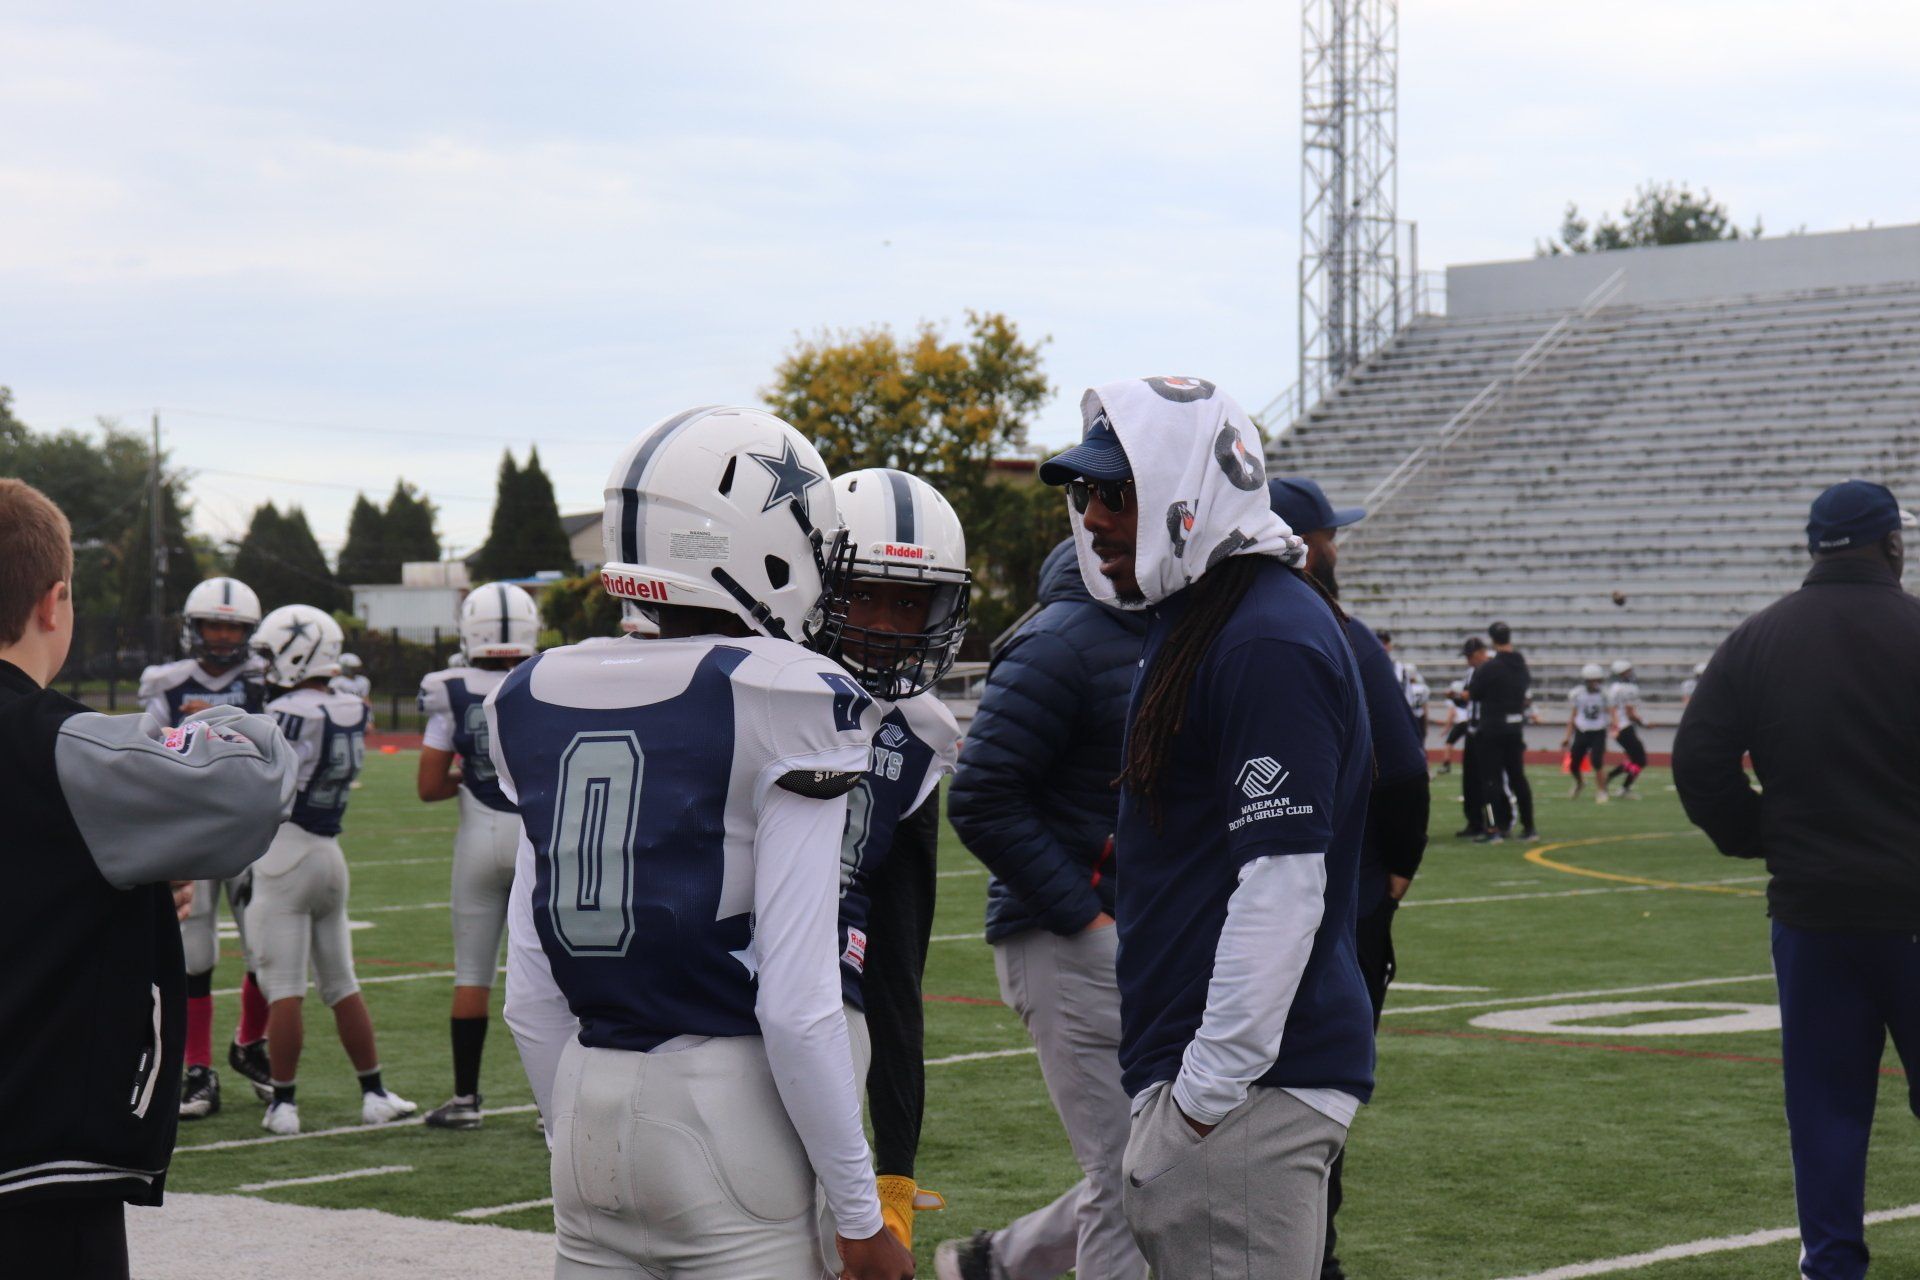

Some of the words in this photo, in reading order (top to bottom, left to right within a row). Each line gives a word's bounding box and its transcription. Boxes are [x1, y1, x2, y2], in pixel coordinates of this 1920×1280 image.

[885, 544, 923, 559] Riddell
[601, 573, 668, 601] Riddell
[1228, 816, 1246, 832] BOYS
[1246, 814, 1253, 822] &
[1253, 807, 1284, 821] GIRLS
[1285, 805, 1313, 815] CLUB
[1240, 797, 1290, 815] WAKEMAN
[549, 730, 645, 957] 0
